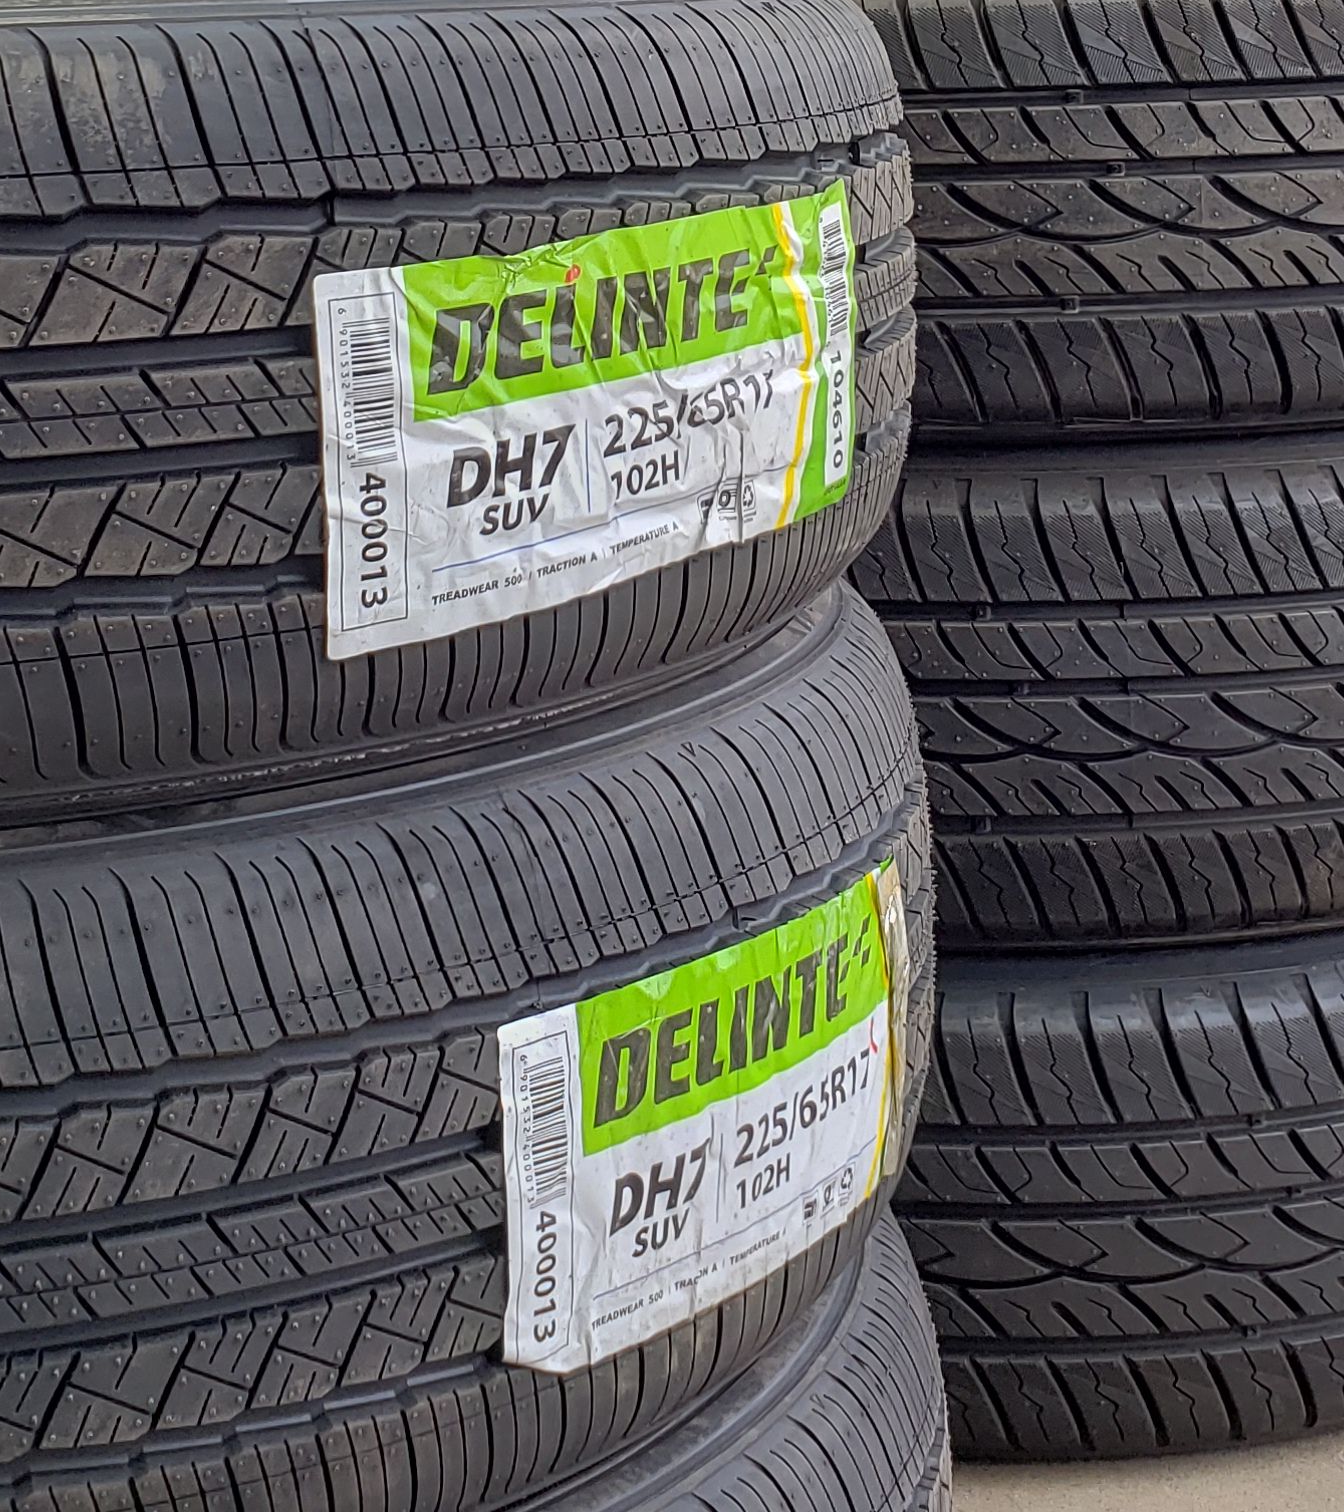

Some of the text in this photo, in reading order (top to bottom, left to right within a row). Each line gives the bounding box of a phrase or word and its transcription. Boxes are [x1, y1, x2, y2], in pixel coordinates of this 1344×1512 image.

[426, 250, 750, 396] DELINTE
[446, 424, 575, 508] DH7
[830, 350, 844, 469] 104610
[358, 473, 388, 608] 400013
[480, 447, 682, 535] SUV 102H
[432, 520, 680, 606] TREADWEAR 500 TRACTION A TEMPERATURE A
[593, 932, 849, 1128] DELINTE
[609, 1048, 871, 1237] DH7 225/65R17
[632, 1152, 792, 1258] SUV 102H
[533, 1210, 558, 1343] 400013
[591, 1297, 644, 1331] TREADWEAR
[648, 1289, 664, 1305] 500
[711, 1262, 719, 1273] A
